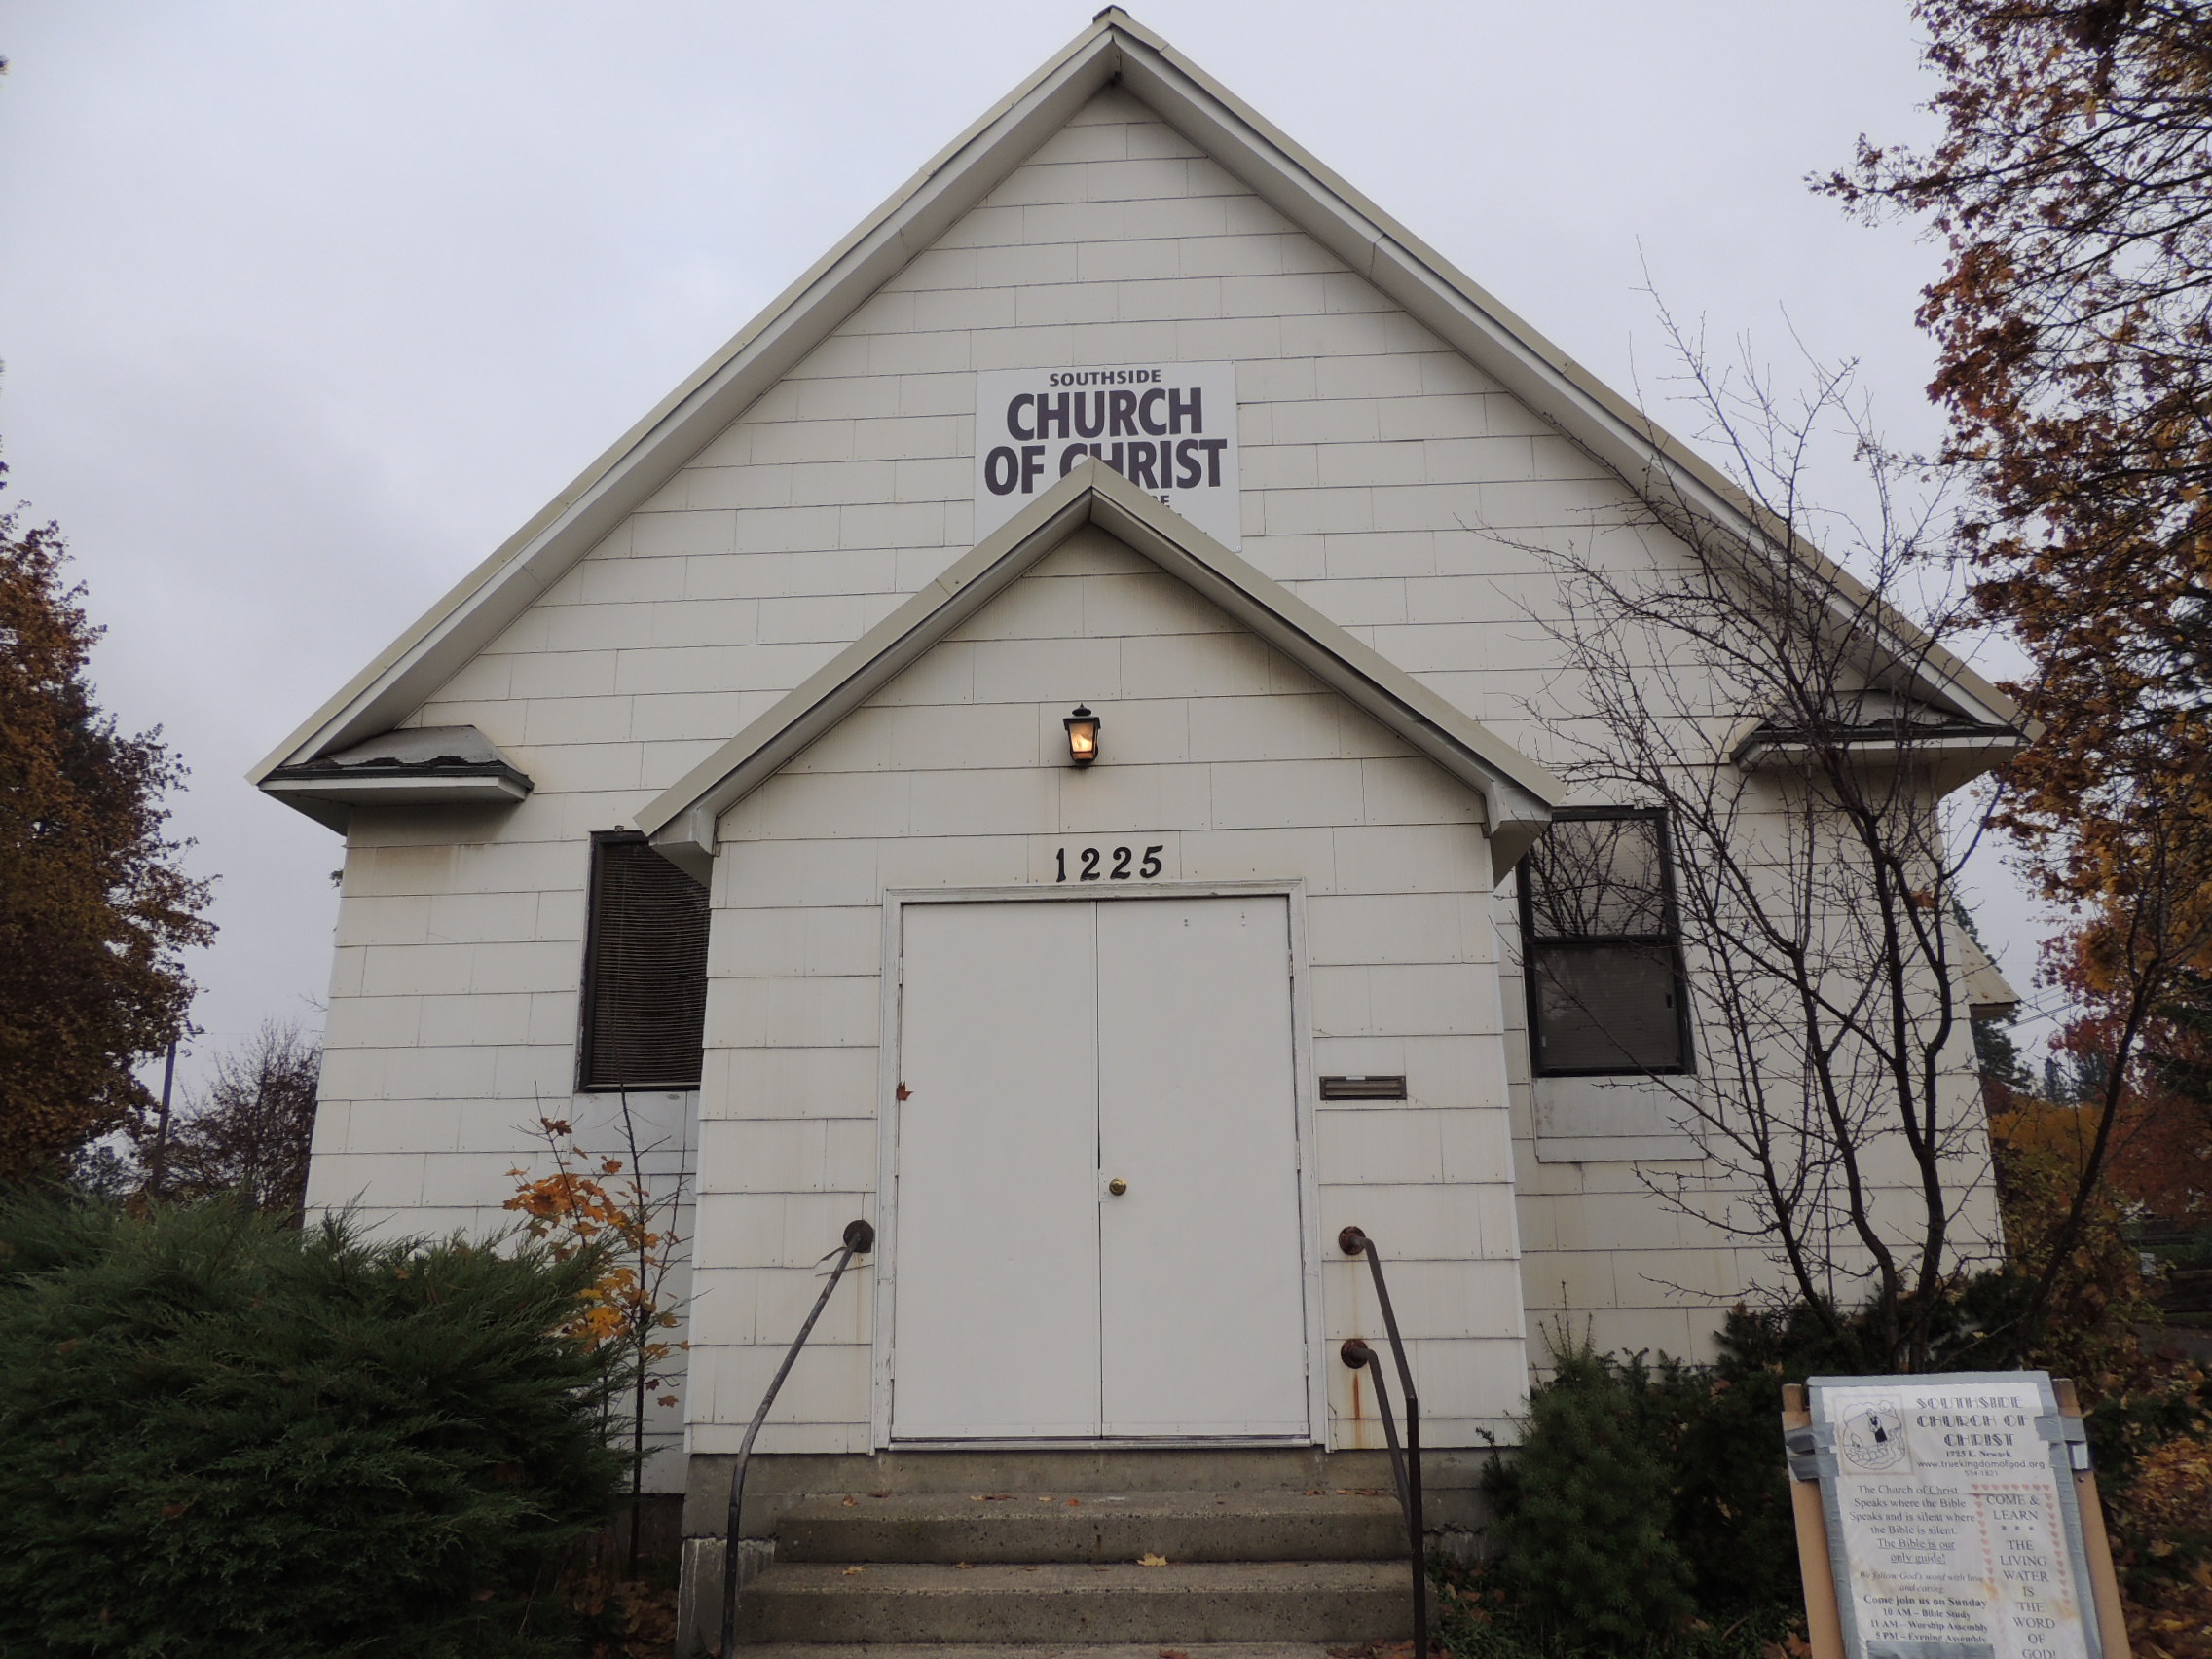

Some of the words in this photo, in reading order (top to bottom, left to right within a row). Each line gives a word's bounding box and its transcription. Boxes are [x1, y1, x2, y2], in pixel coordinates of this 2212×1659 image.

[1049, 369, 1161, 387] SOUTHSIDE
[1006, 387, 1202, 441] CHURCH
[984, 445, 1046, 496] OF
[1056, 844, 1163, 883] 1225
[1916, 1396, 2024, 1409] SOUTHSIDE
[1916, 1415, 1996, 1427] CHURCH
[2003, 1415, 2027, 1427] OF
[1944, 1433, 2014, 1447] CHRIST
[1916, 1459, 2046, 1469] www.truekingdomofgod.org
[1858, 1485, 1876, 1494] The
[1878, 1485, 1914, 1494] Church
[1916, 1485, 1928, 1494] of
[1929, 1485, 1959, 1495] Christ
[1854, 1498, 1887, 1509] Speaks
[1890, 1498, 1920, 1508] where
[1922, 1499, 1937, 1508] the
[1939, 1499, 1967, 1508] Bible
[1986, 1494, 2025, 1505] COME
[2030, 1494, 2040, 1505] &
[1849, 1512, 1883, 1522] Speaks
[1885, 1512, 1902, 1521] and
[1905, 1512, 1914, 1521] is
[1917, 1512, 1944, 1522] silent
[1946, 1513, 1975, 1522] where
[1993, 1510, 2038, 1520] LEARN
[1870, 1525, 1886, 1534] the
[1889, 1525, 1914, 1534] Bible
[1917, 1525, 1926, 1534] is
[1928, 1526, 1958, 1535] silent.
[1877, 1538, 1896, 1548] The
[1899, 1538, 1925, 1549] Bible
[1928, 1539, 1936, 1549] is
[1938, 1541, 1955, 1550] our
[2007, 1540, 2035, 1550] THE
[1891, 1553, 1911, 1563] only
[1915, 1553, 1946, 1564] guide!
[2000, 1555, 2046, 1566] LIVING
[1872, 1571, 1897, 1580] follow
[2003, 1569, 2049, 1582] WATER
[2022, 1586, 2034, 1597] IS
[1863, 1594, 1893, 1604] Come
[1947, 1597, 1987, 1609] Sunday
[2016, 1602, 2045, 1612] THE
[1883, 1607, 1893, 1616] 10
[1946, 1609, 1971, 1621] Study
[1870, 1619, 1879, 1628] 11
[1908, 1620, 1944, 1631] Worship
[1947, 1622, 1988, 1634] Assembly
[2012, 1617, 2055, 1629] WORD
[1883, 1632, 1899, 1641] PM
[1908, 1632, 1943, 1641] Evening
[1946, 1635, 1986, 1643] Assembly
[2027, 1634, 2046, 1644] OF
